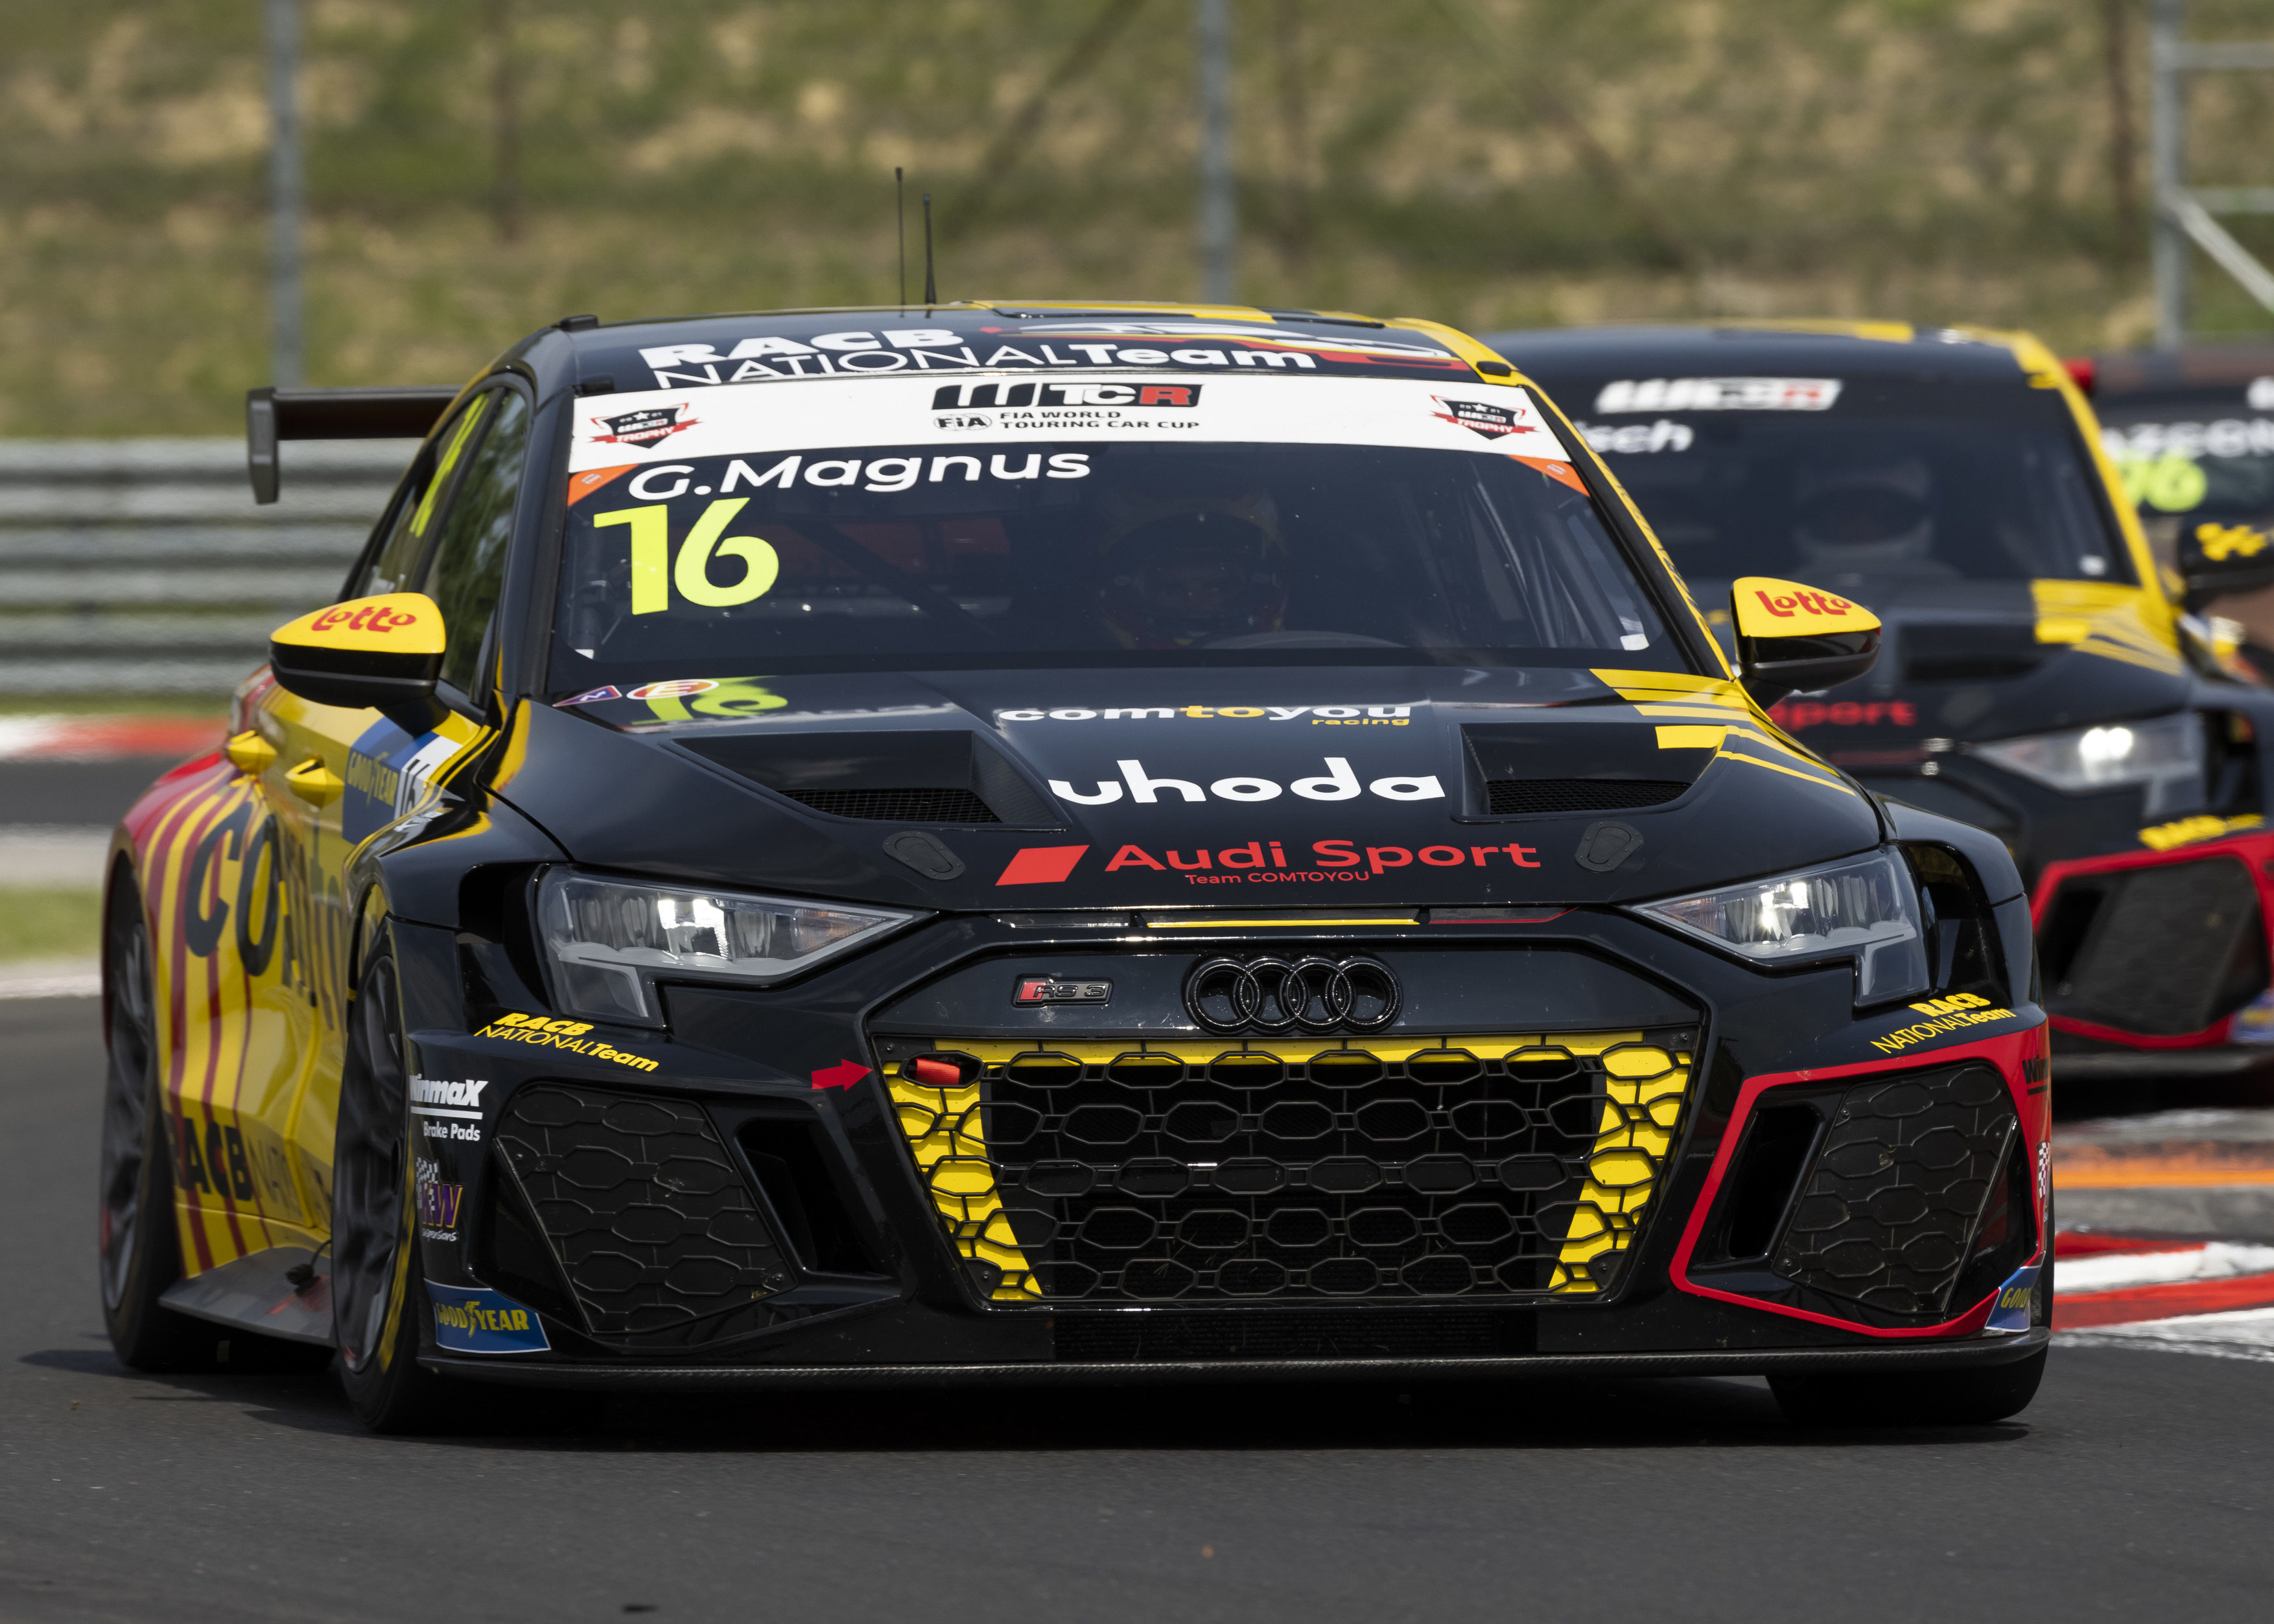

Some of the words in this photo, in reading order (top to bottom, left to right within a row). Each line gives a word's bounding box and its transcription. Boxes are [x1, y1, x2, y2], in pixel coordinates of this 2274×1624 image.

[639, 329, 965, 369] RACB
[932, 382, 1206, 410] WTCR
[616, 426, 675, 442] TROPHY
[1456, 419, 1513, 433] TROPHY
[628, 452, 1091, 500] G.Magnus
[593, 497, 780, 616] 16
[998, 705, 1412, 721] comtoyou
[1312, 718, 1411, 726] racing
[1048, 757, 1446, 806] uhoda
[1105, 841, 1287, 872] Audi
[1312, 840, 1541, 874] Sport
[1186, 874, 1242, 885] Team
[1248, 872, 1369, 883] COMTOYOU
[1033, 985, 1078, 998] RS
[1084, 984, 1106, 997] 3
[1908, 993, 1991, 1017] RACB
[493, 1012, 594, 1036] RACB
[423, 1121, 448, 1139] Brake
[451, 1123, 481, 1141] Pads
